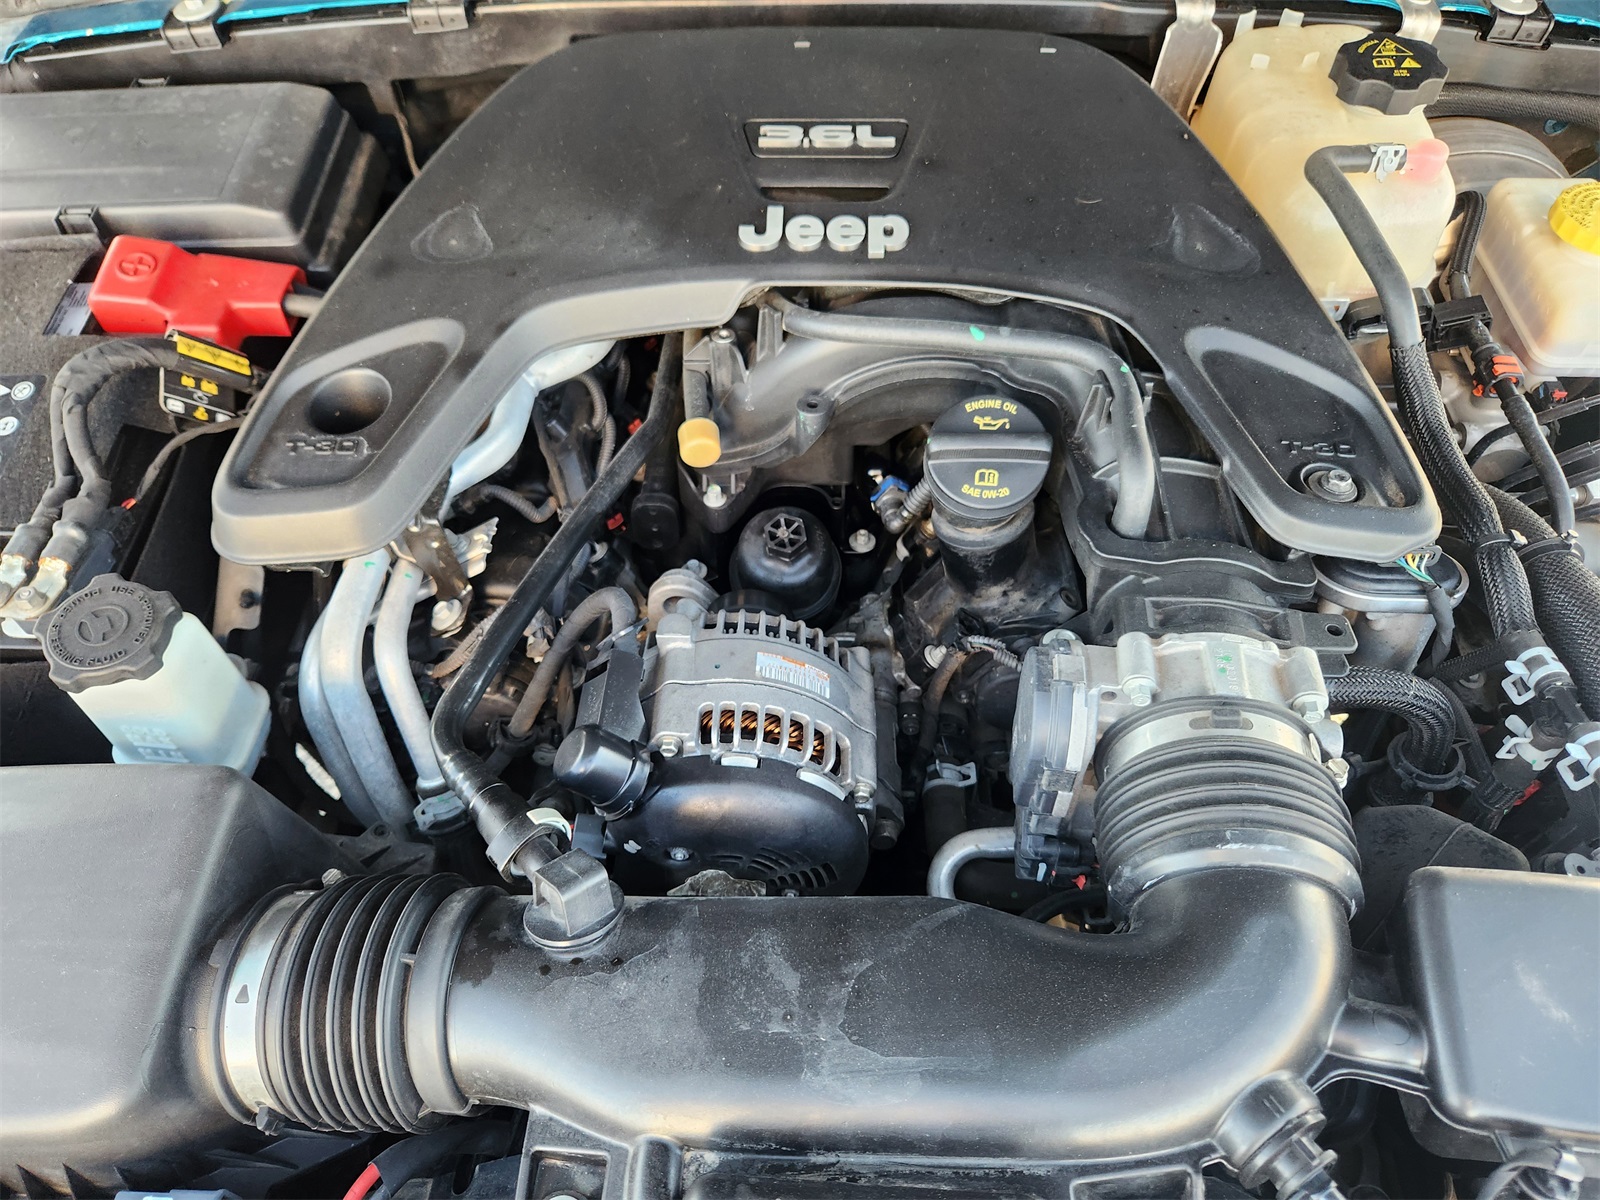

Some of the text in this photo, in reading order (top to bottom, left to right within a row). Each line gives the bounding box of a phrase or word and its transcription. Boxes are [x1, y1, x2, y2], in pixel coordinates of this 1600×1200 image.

[757, 124, 896, 148] 3.6L
[738, 204, 910, 259] Jeep
[964, 399, 1018, 415] ENGINE OIL
[285, 439, 359, 457] T-30
[1280, 439, 1357, 458] T-30
[961, 484, 1010, 499] SAE 0W-20
